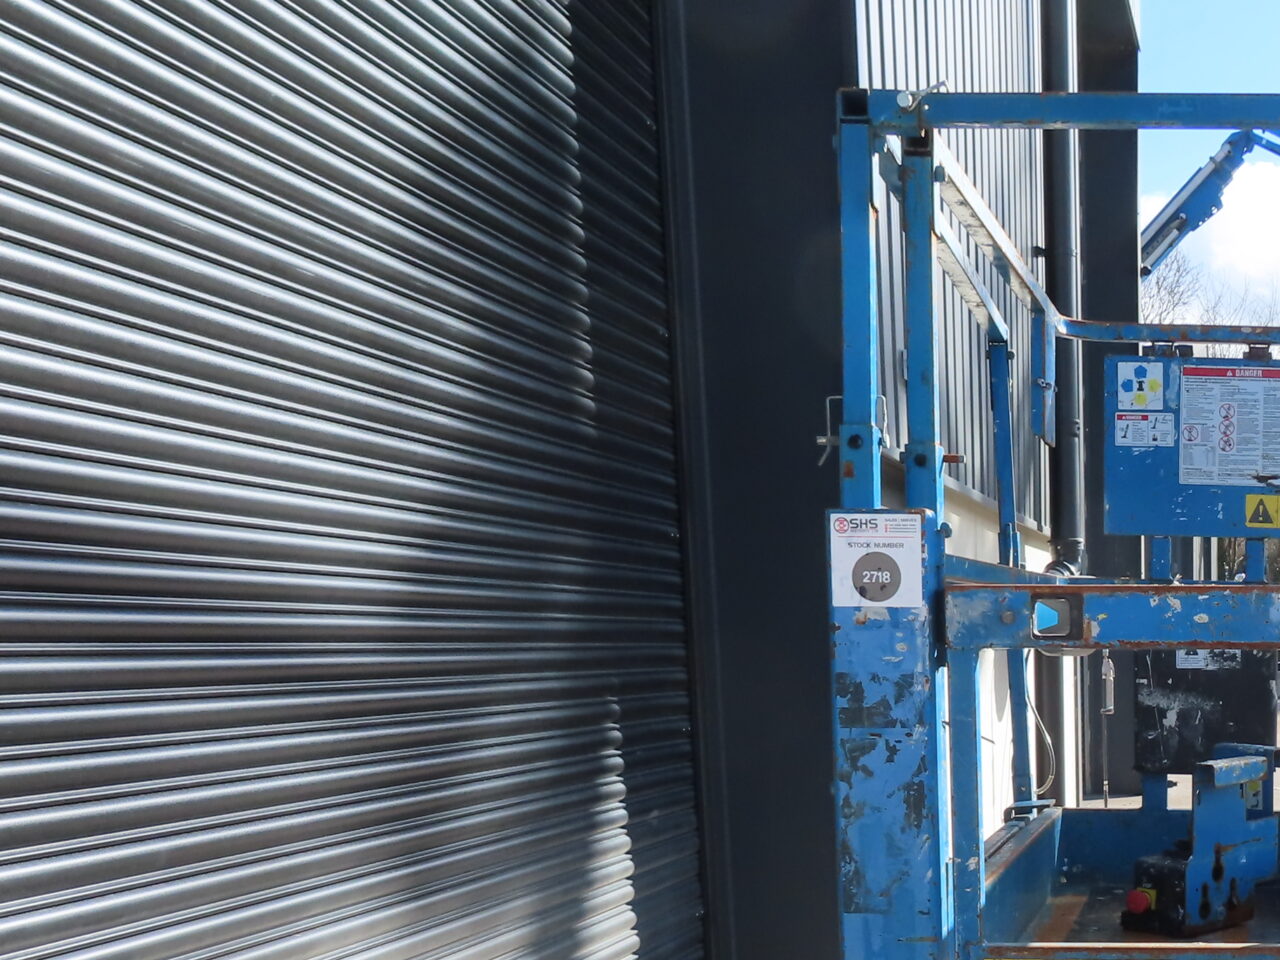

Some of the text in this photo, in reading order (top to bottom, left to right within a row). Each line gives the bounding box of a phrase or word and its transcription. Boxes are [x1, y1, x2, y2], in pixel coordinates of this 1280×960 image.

[1235, 369, 1263, 377] DANGER
[849, 518, 878, 529] SHS
[862, 571, 891, 583] 2718
